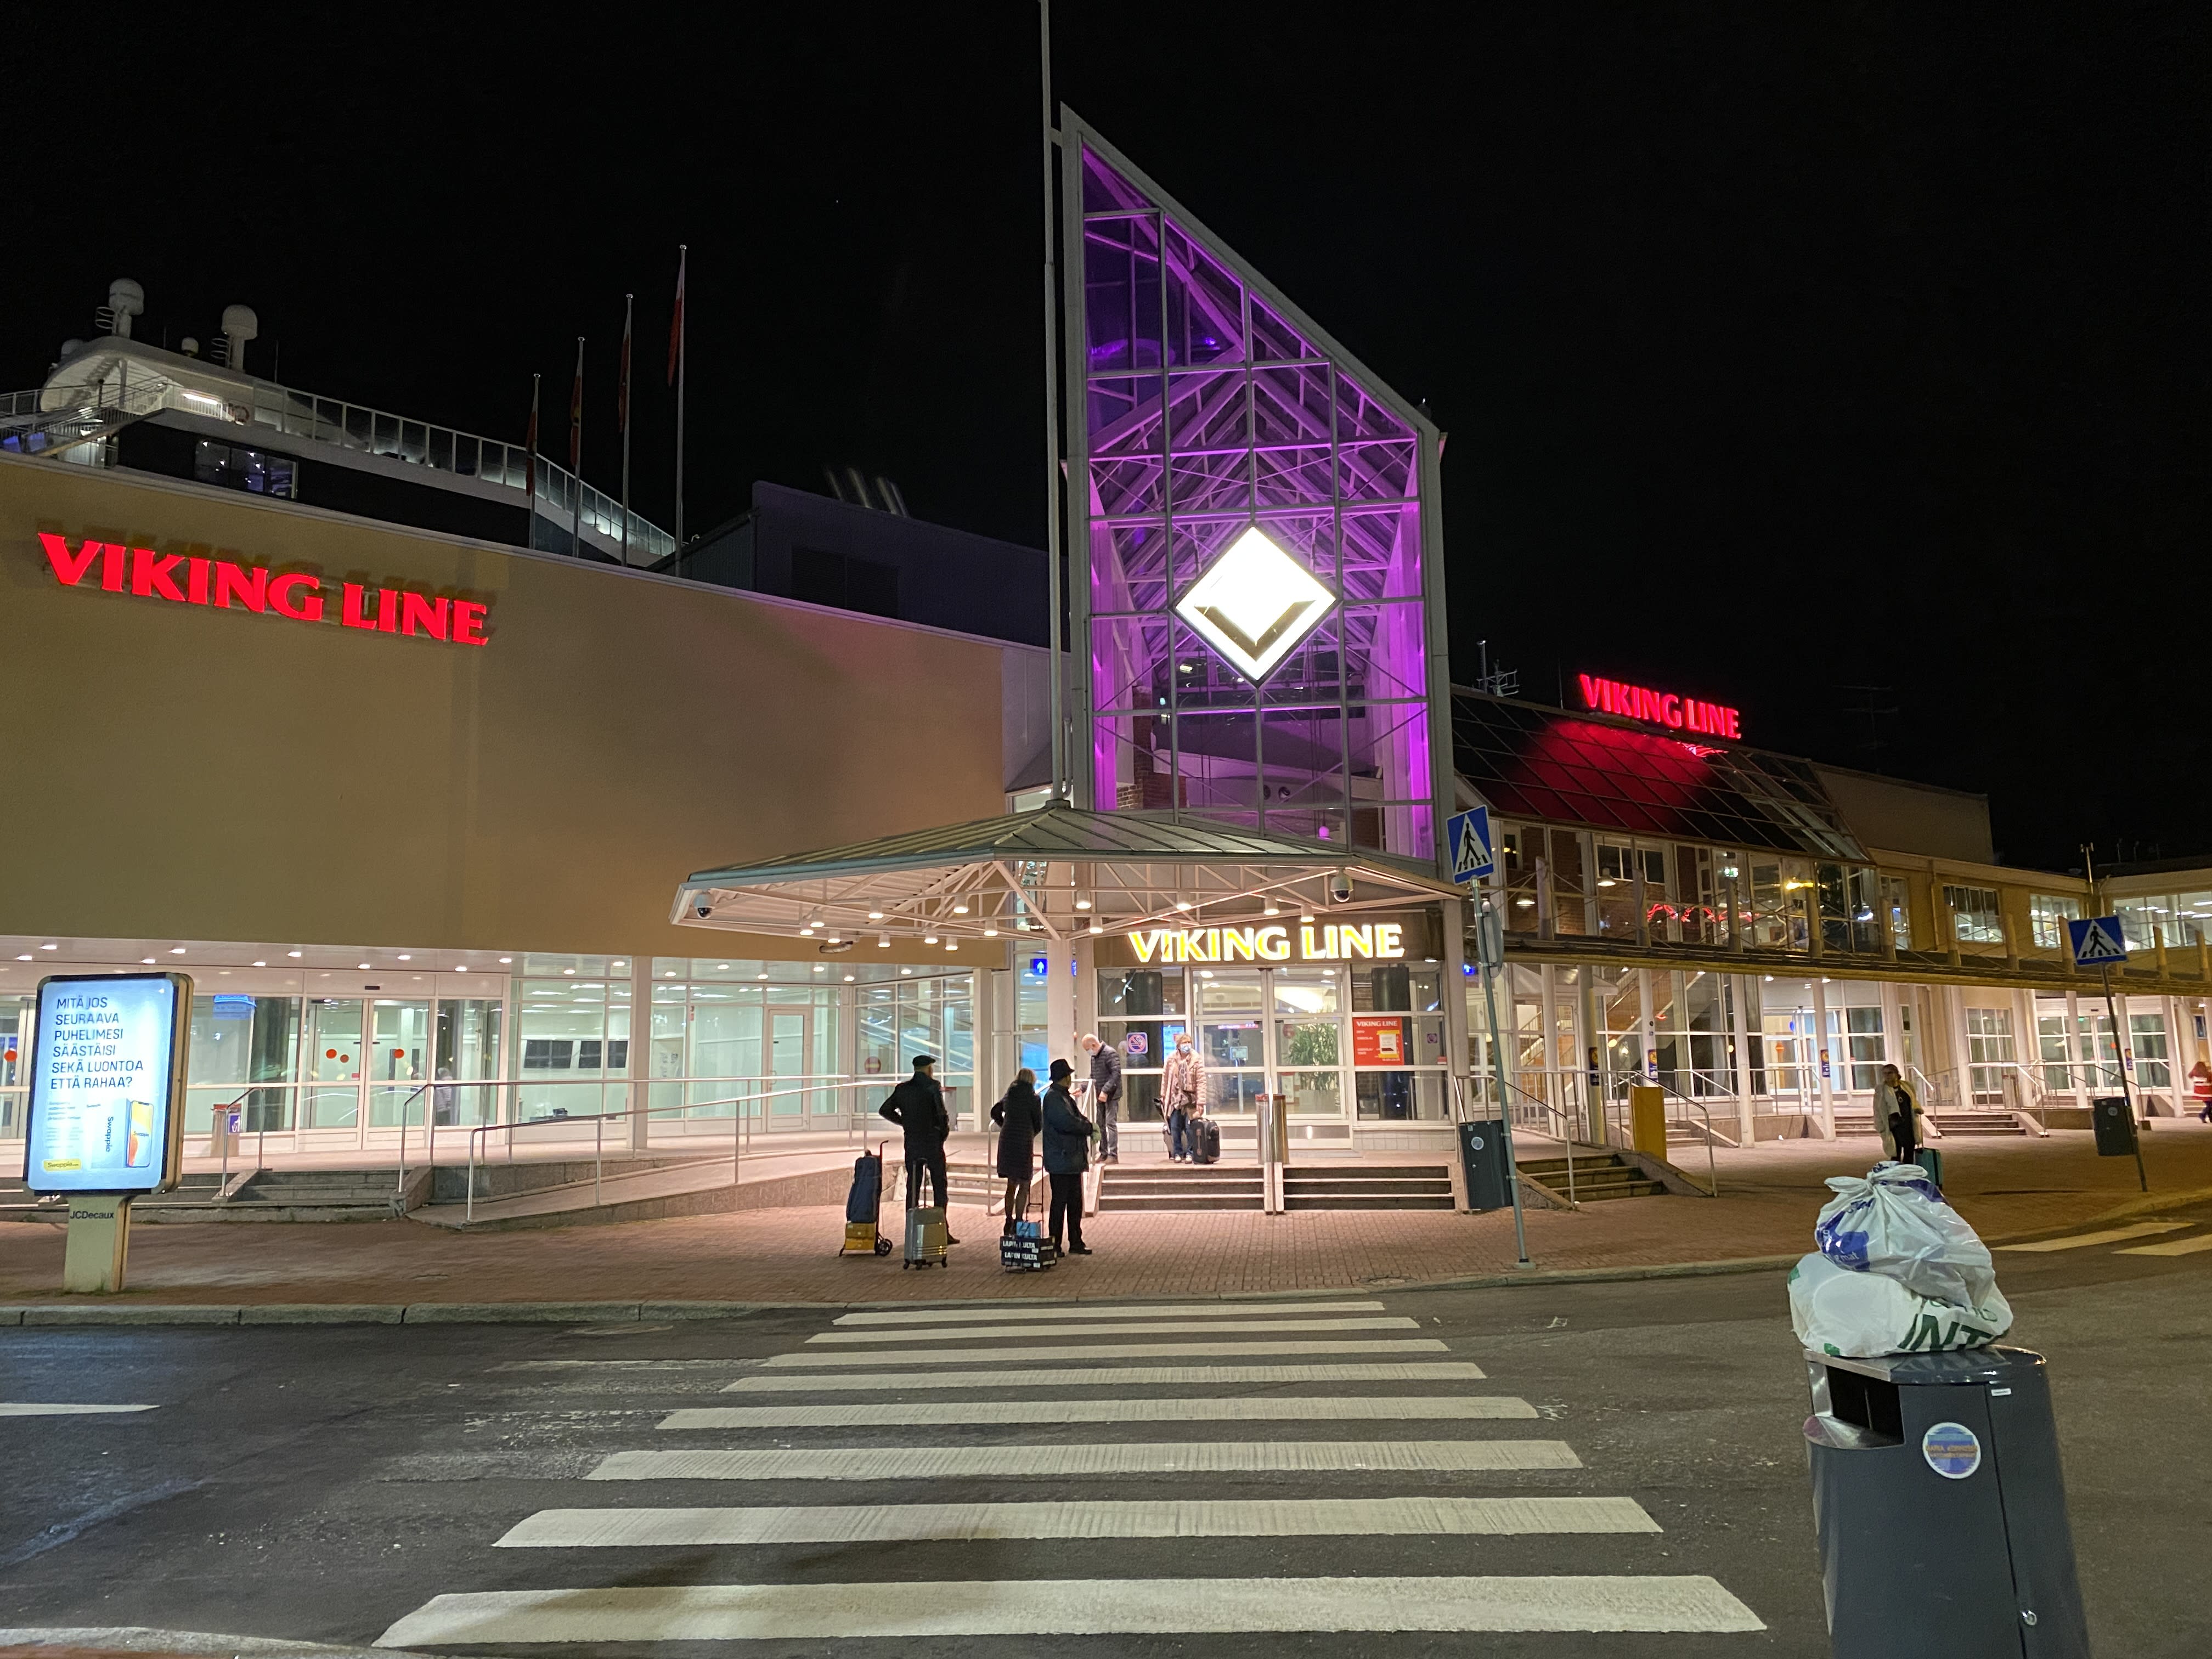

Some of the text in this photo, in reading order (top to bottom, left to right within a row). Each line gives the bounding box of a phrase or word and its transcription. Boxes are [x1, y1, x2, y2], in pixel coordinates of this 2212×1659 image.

[38, 532, 488, 646] VIKING LINE
[1579, 674, 1741, 739] VIKING LINE
[1128, 924, 1405, 963] VIKING LINE
[57, 995, 108, 1009] MITÄ JOS
[55, 1013, 119, 1025] SEURAAVA
[54, 1029, 123, 1041] PUHELIMESI
[53, 1042, 116, 1057] SÄÄSTÄISI
[52, 1059, 143, 1073] SEKÄ LUONTOA
[50, 1075, 133, 1090] ETTÄ RAHAA?
[104, 1116, 114, 1153] Swappie
[70, 1211, 114, 1220] JCDecaux
